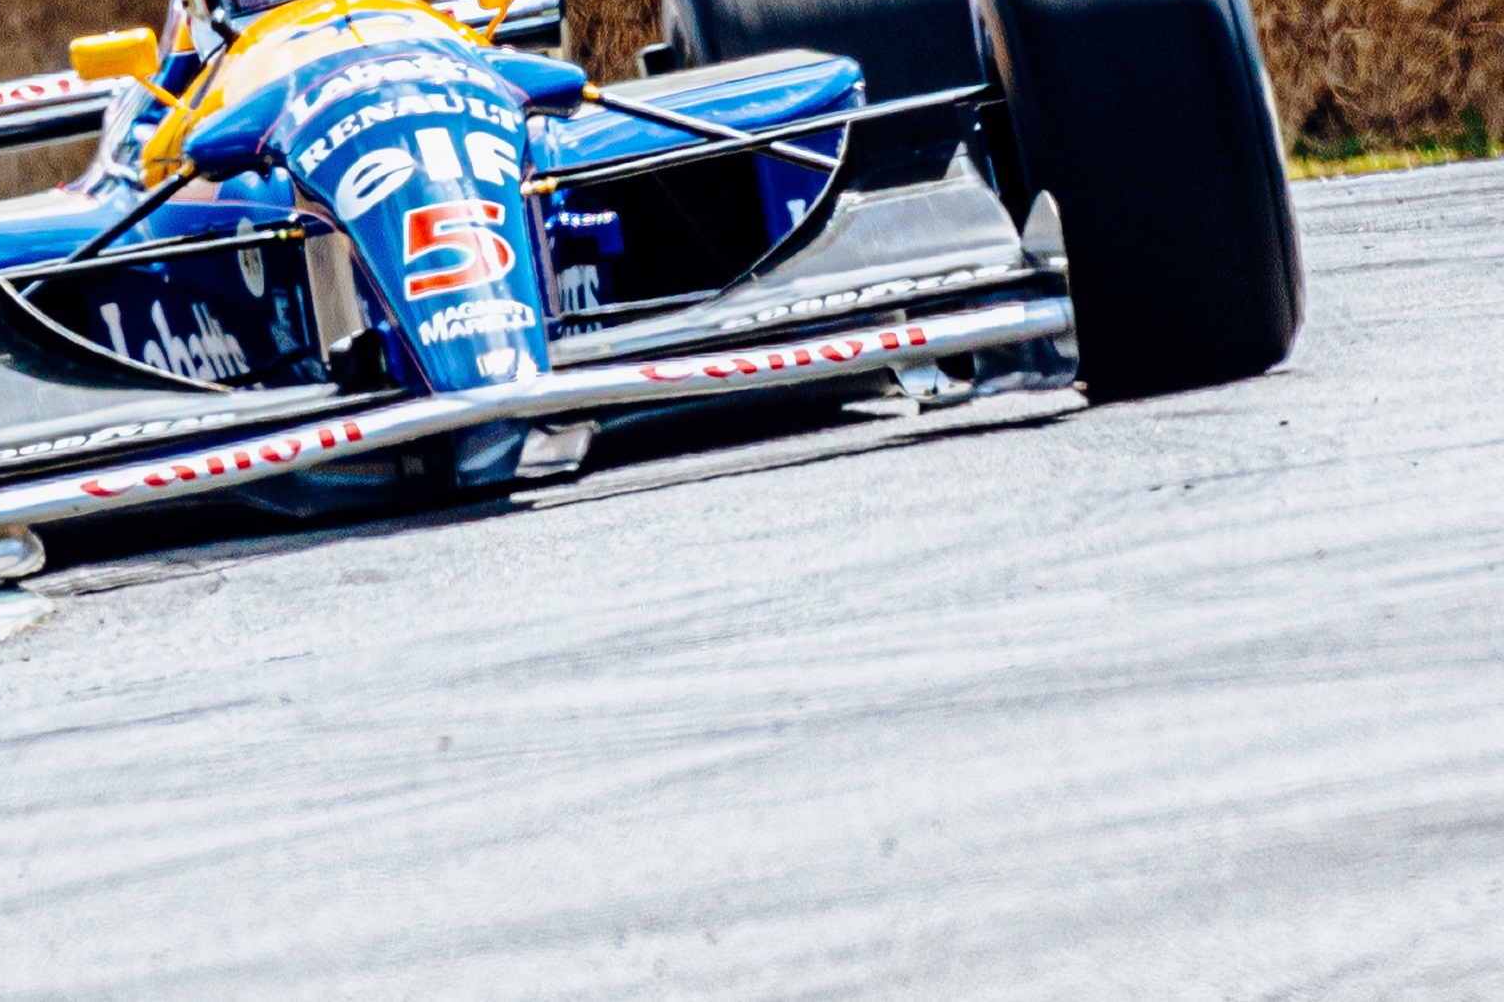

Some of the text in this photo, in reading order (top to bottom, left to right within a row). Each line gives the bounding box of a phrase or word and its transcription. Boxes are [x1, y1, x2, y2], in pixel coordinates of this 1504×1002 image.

[297, 93, 523, 178] RENAULT
[335, 126, 522, 221] elf
[403, 199, 517, 303] 5
[638, 326, 928, 382] Canon
[79, 421, 364, 498] Canon
